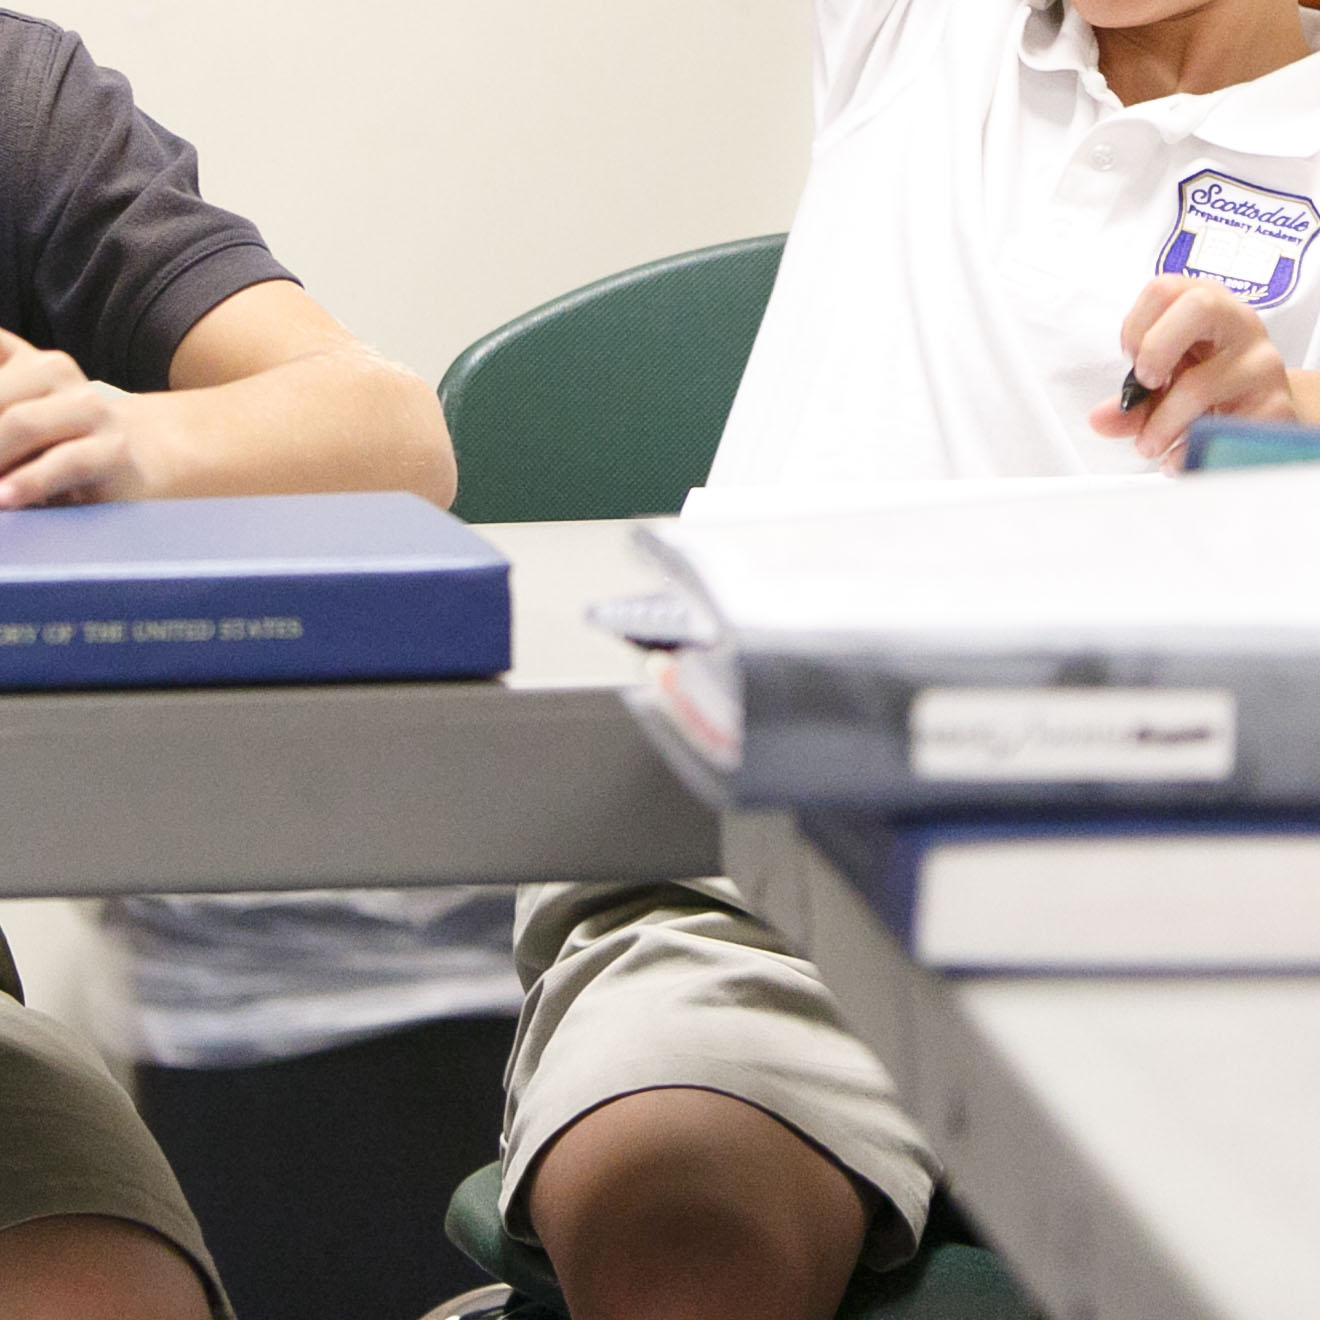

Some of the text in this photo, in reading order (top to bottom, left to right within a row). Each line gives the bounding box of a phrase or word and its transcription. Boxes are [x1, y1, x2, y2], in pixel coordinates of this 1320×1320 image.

[1187, 204, 1304, 247] Preparatory Academy
[1191, 184, 1309, 232] Scottsdale
[41, 622, 73, 646] OF
[131, 618, 216, 643] UNITED
[218, 616, 303, 641] STATES
